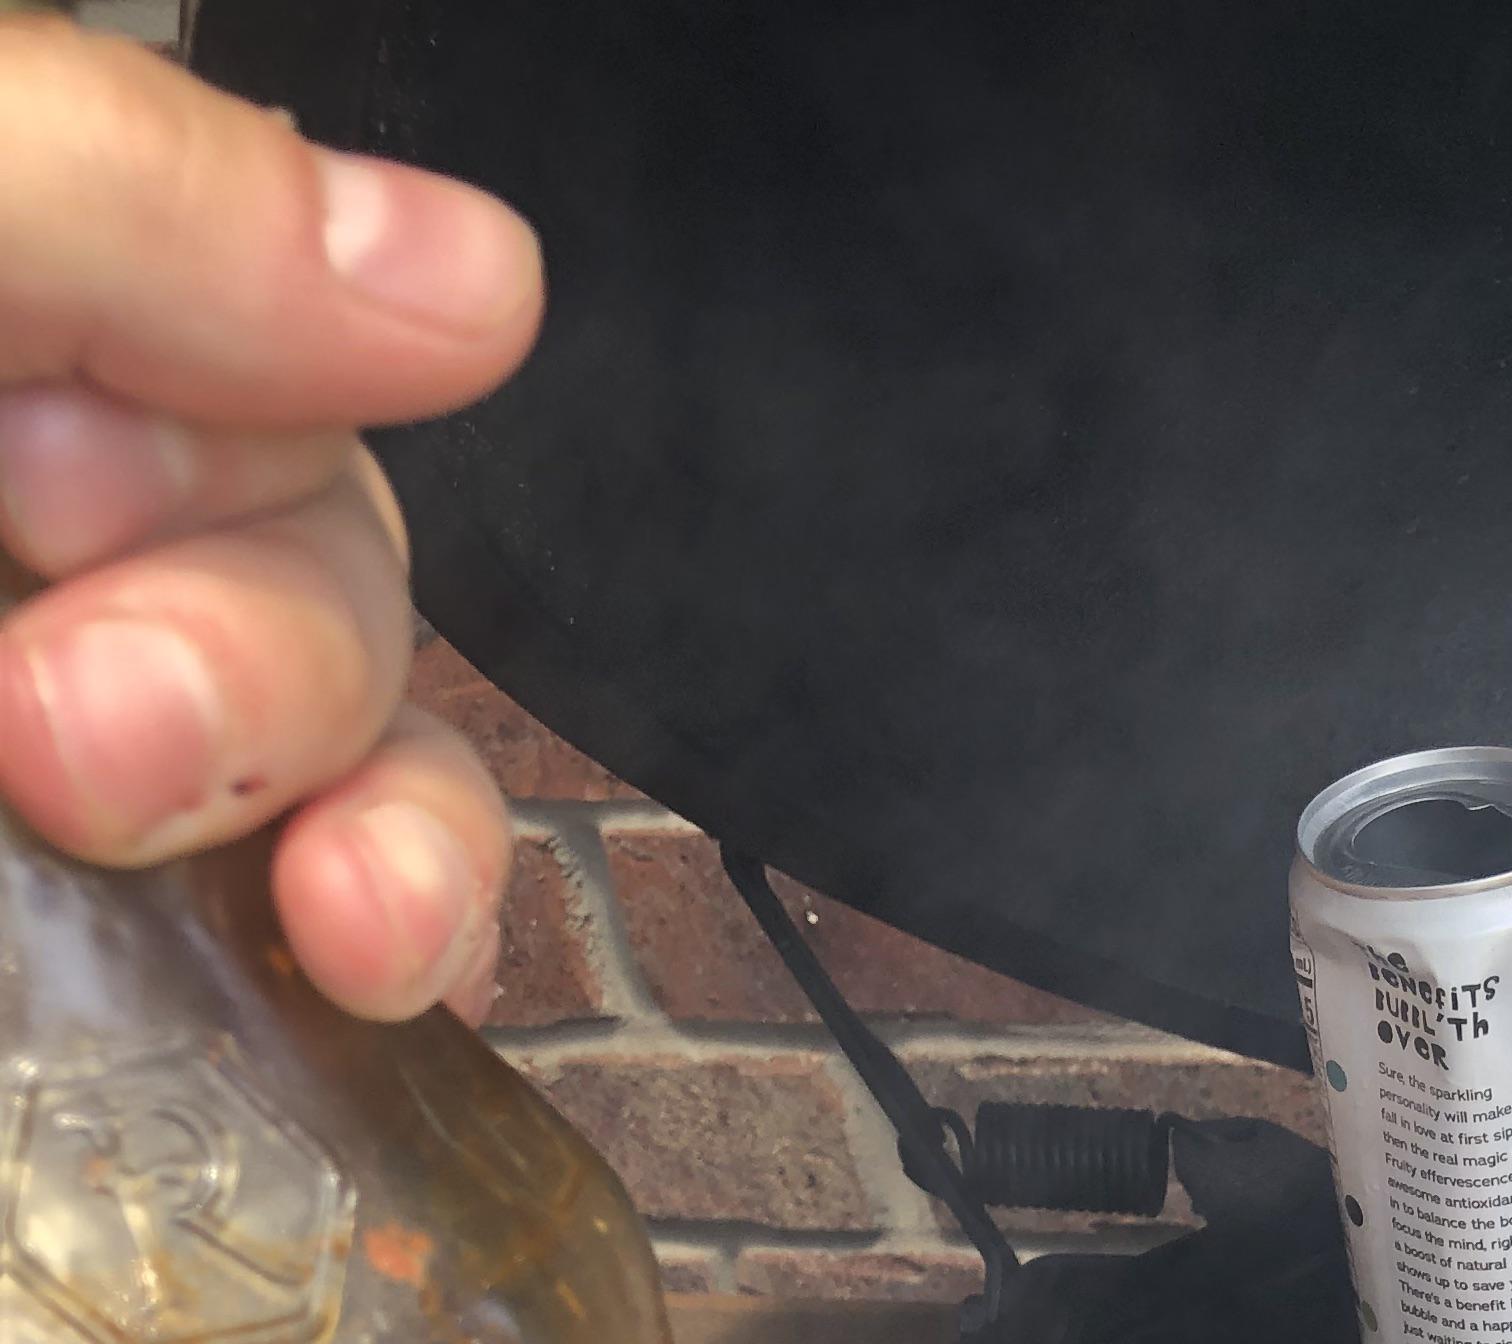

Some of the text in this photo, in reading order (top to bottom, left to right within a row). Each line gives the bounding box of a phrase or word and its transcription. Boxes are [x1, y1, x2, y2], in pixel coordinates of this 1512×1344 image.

[1378, 1061, 1492, 1101] Sure, the sparkling
[1379, 1087, 1440, 1121] personality
[1444, 1112, 1467, 1123] will
[1473, 1105, 1512, 1123] make
[1381, 1108, 1397, 1124] fall
[1401, 1117, 1410, 1130] in
[1414, 1122, 1436, 1140] love
[1440, 1129, 1453, 1144] at
[1458, 1132, 1489, 1145] first
[1383, 1131, 1407, 1149] then
[1410, 1142, 1429, 1159] the
[1433, 1151, 1458, 1165] real
[1463, 1151, 1508, 1173] magic
[1385, 1153, 1416, 1177] Fruity
[1387, 1176, 1441, 1205] awesome
[1402, 1201, 1414, 1216] to
[1417, 1205, 1467, 1230] balance
[1472, 1216, 1495, 1229] the
[1392, 1216, 1421, 1239] focus
[1425, 1229, 1444, 1247] the
[1449, 1237, 1487, 1252] mind,
[1404, 1242, 1437, 1264] boost
[1440, 1256, 1452, 1268] of
[1457, 1258, 1507, 1271] natural
[1397, 1260, 1432, 1283] shows
[1435, 1276, 1450, 1289] up
[1454, 1278, 1468, 1291] to
[1472, 1282, 1505, 1291] save
[1399, 1279, 1441, 1306] There's
[1444, 1298, 1452, 1308] a
[1456, 1299, 1506, 1312] benefit
[1401, 1300, 1438, 1324] bubble
[1442, 1314, 1465, 1331] and
[1470, 1321, 1478, 1331] a
[1404, 1321, 1424, 1339] just
